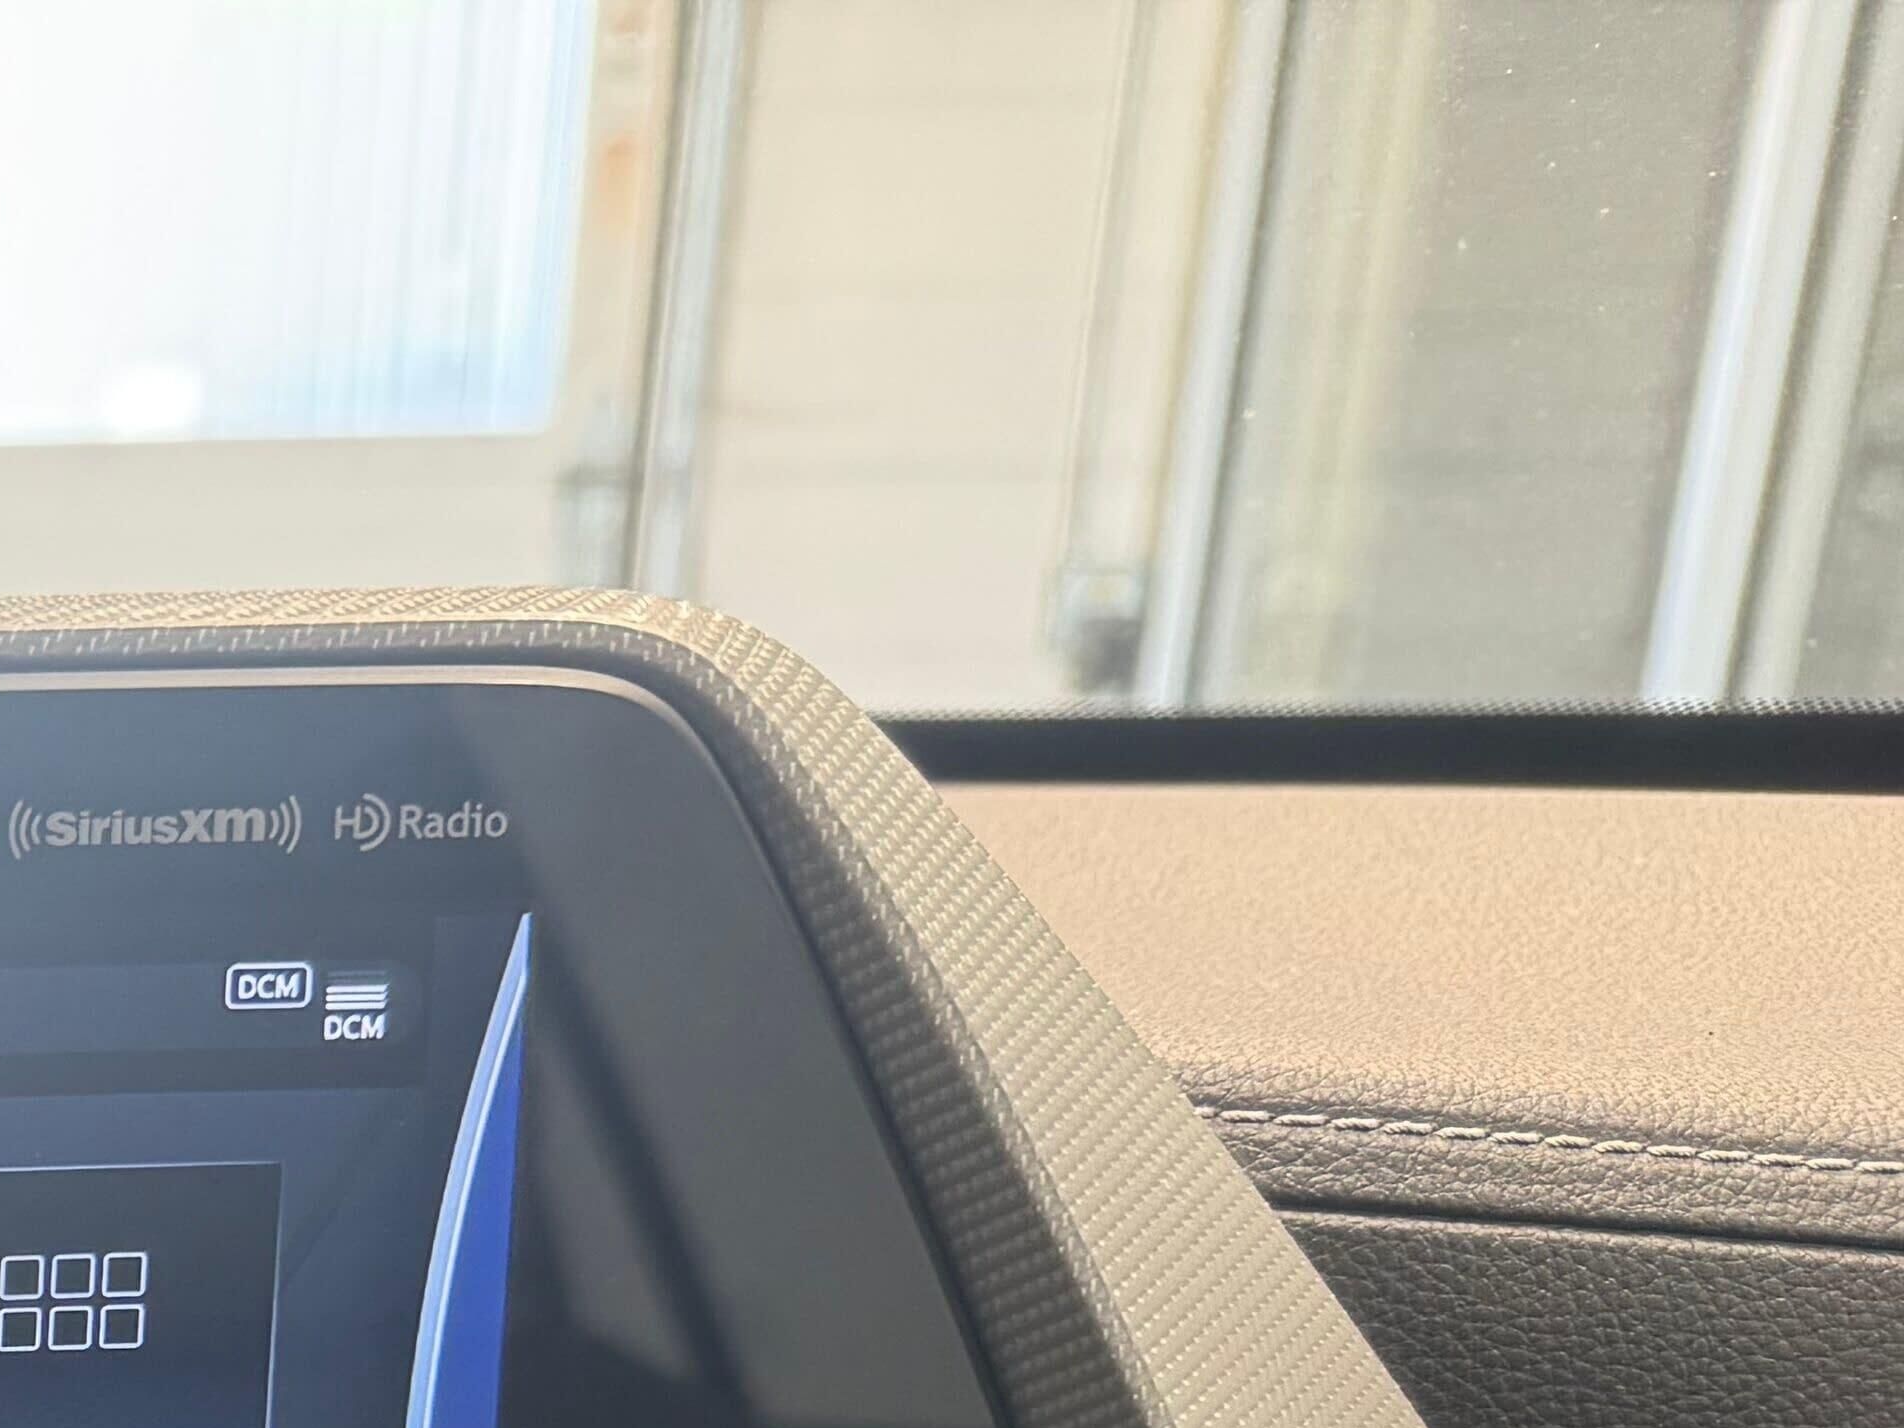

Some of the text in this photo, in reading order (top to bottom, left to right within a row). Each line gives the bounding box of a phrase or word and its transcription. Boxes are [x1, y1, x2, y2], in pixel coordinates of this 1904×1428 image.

[397, 800, 510, 841] Radio
[236, 972, 301, 1002] DCM
[322, 1013, 386, 1041] DCM
